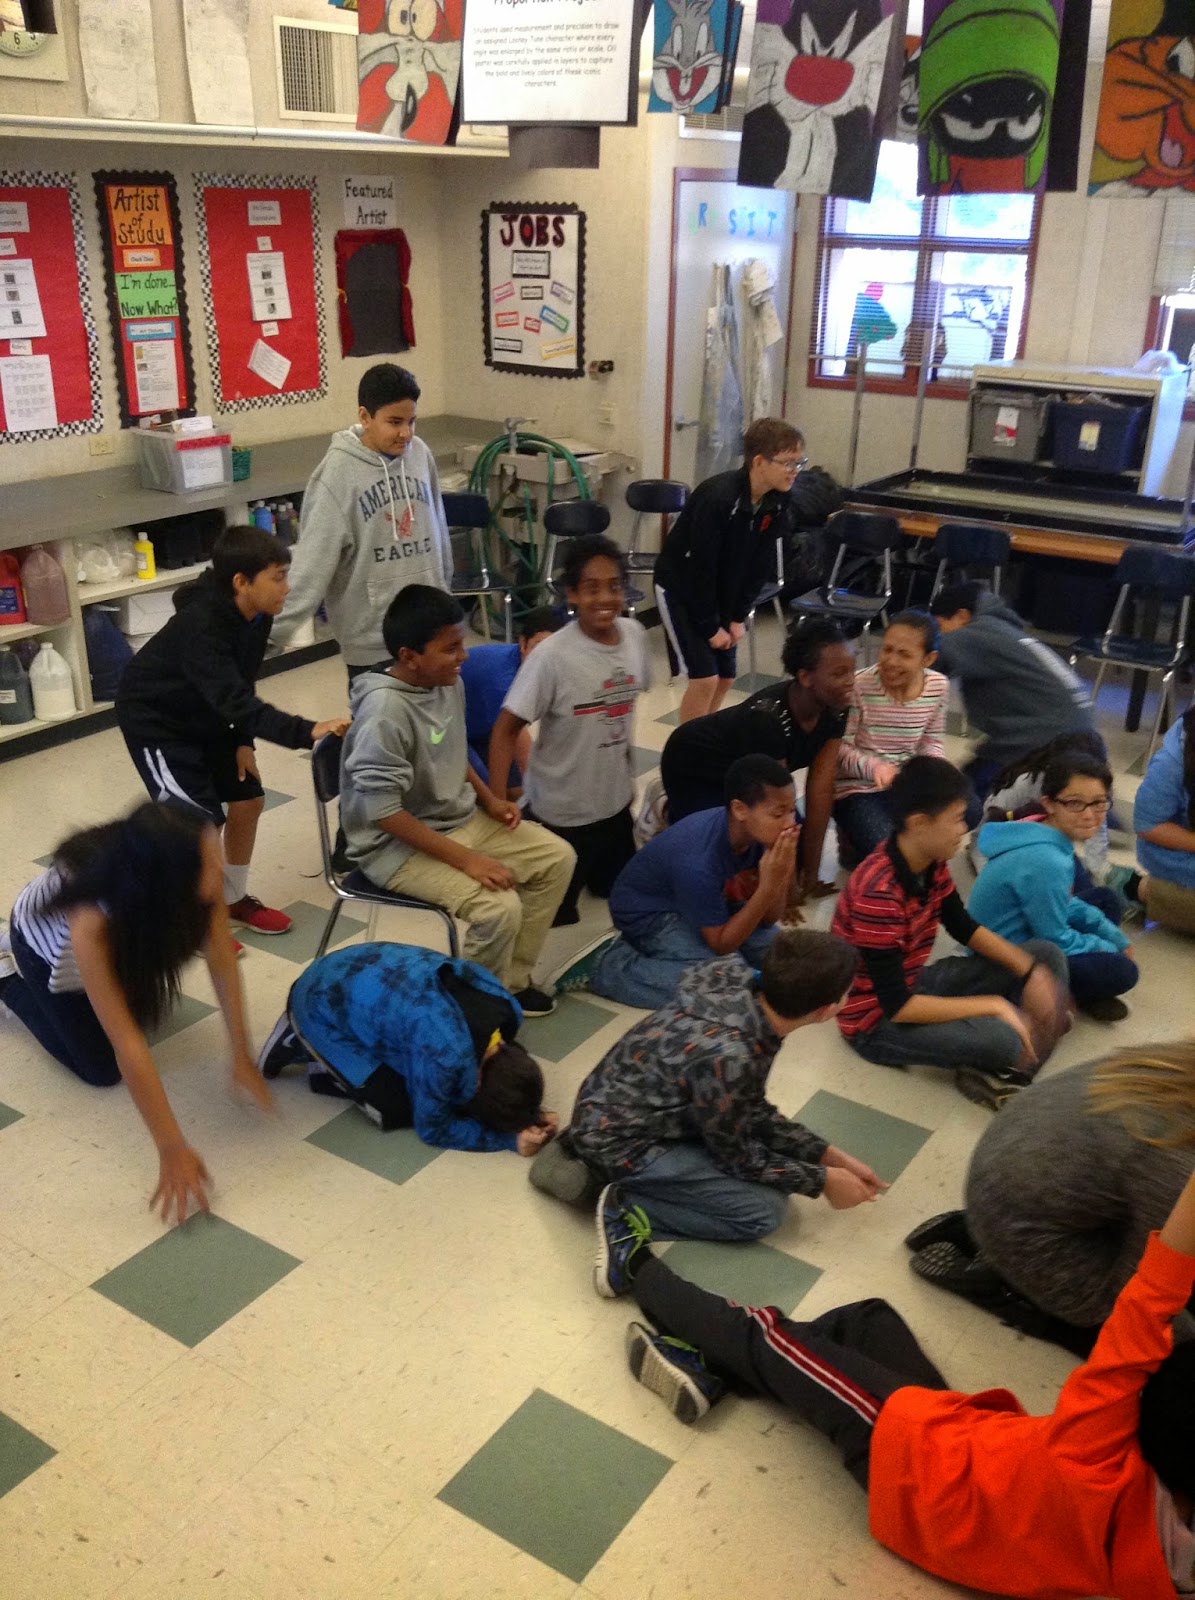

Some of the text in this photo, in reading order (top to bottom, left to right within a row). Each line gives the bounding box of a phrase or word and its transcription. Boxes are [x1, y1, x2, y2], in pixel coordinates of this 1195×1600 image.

[514, 24, 552, 32] measurement
[553, 23, 564, 31] and
[566, 22, 594, 31] precision
[595, 22, 602, 30] to
[604, 20, 619, 30] draw
[14, 32, 21, 45] 6
[483, 38, 507, 46] assigned
[597, 34, 614, 43] every
[500, 48, 525, 56] enlarged
[526, 47, 533, 55] by
[607, 44, 617, 52] Oil
[532, 58, 552, 66] applied
[561, 57, 578, 66] layers
[537, 68, 554, 76] colors
[345, 178, 393, 199] Featured
[113, 188, 160, 212] Artist
[132, 213, 144, 229] of
[356, 205, 388, 225] Artist
[118, 219, 166, 245] Study
[500, 214, 566, 248] JOBS
[120, 274, 142, 290] I'm
[121, 297, 179, 318] Now What?
[374, 537, 432, 563] EAGLE
